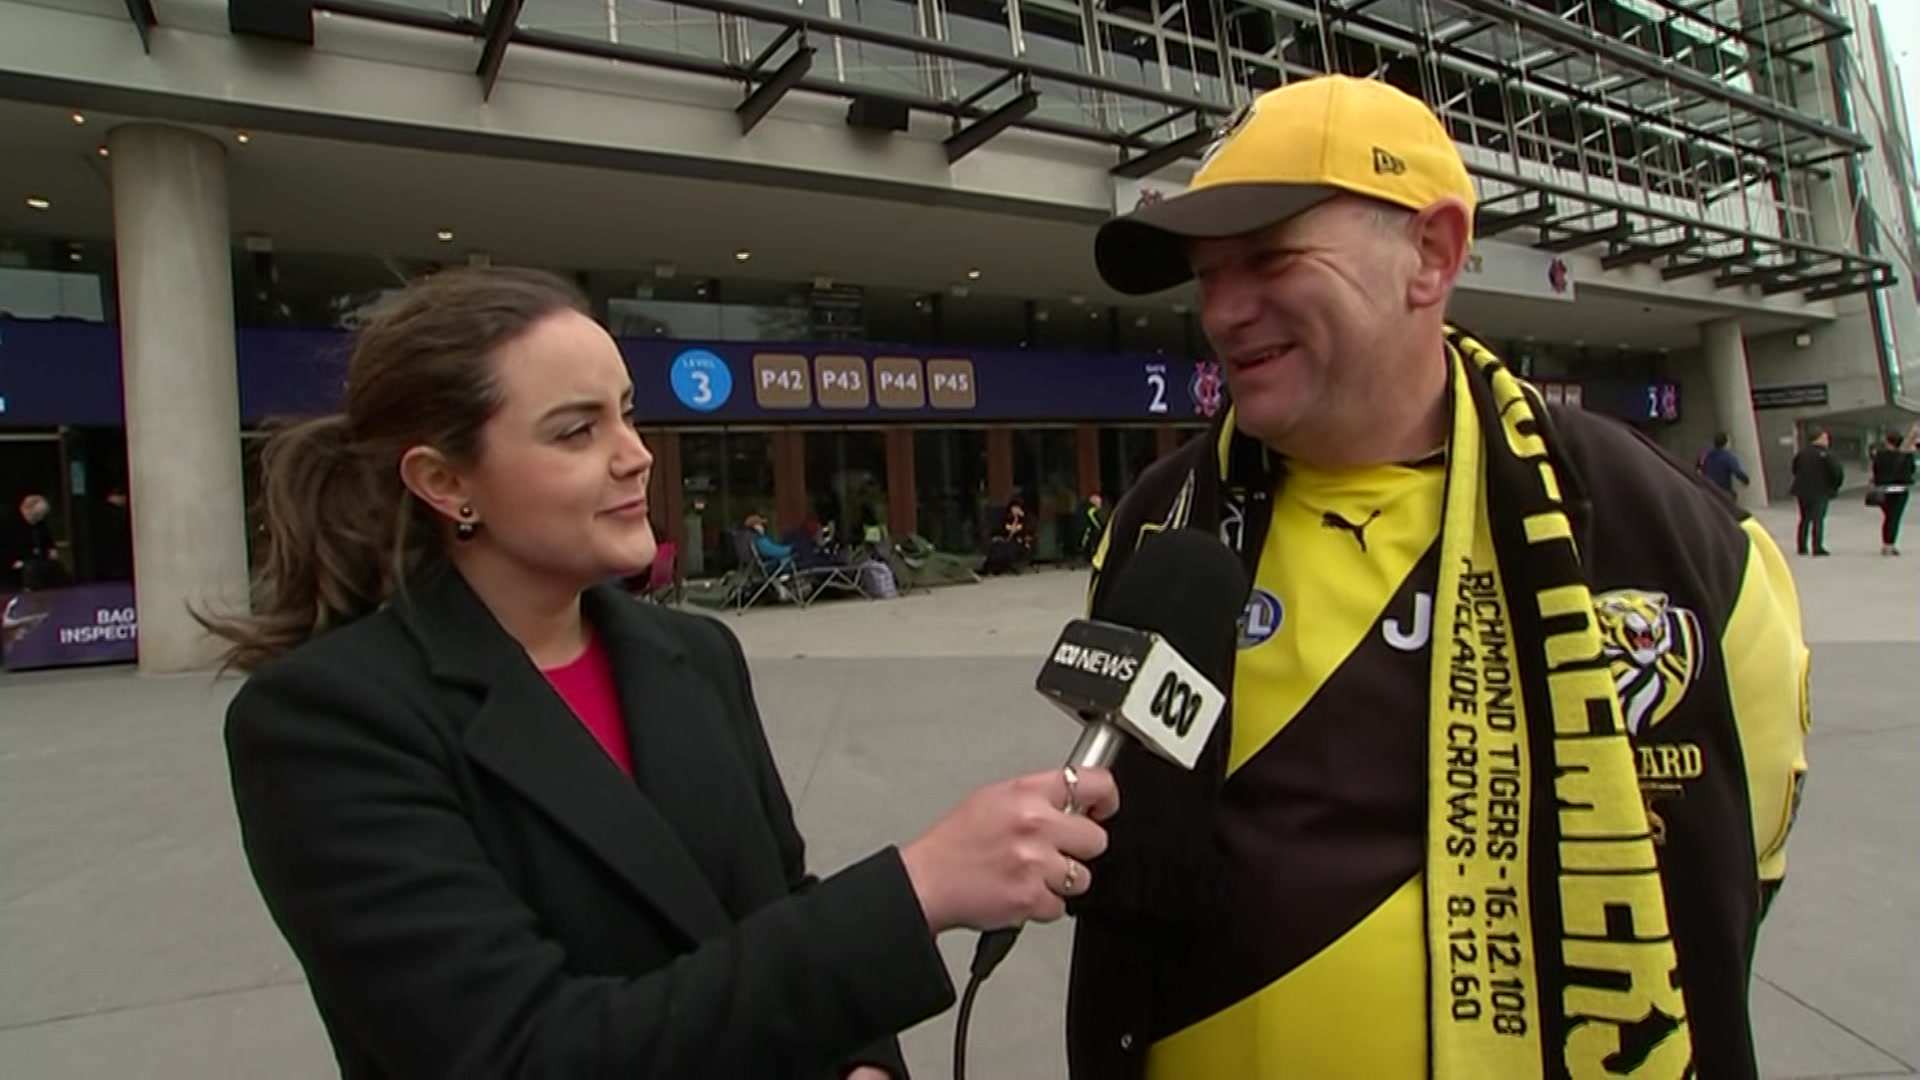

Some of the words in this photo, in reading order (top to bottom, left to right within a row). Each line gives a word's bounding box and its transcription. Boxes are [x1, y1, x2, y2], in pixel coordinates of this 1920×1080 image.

[691, 370, 713, 403] 3
[761, 369, 803, 391] P42
[821, 371, 861, 391] P43
[880, 371, 918, 391] P44
[933, 372, 969, 391] P45
[1147, 374, 1168, 413] 2
[1076, 645, 1139, 682] NEWS
[1472, 571, 1516, 733] RICHMOND
[1447, 895, 1482, 1022] 8.12.60
